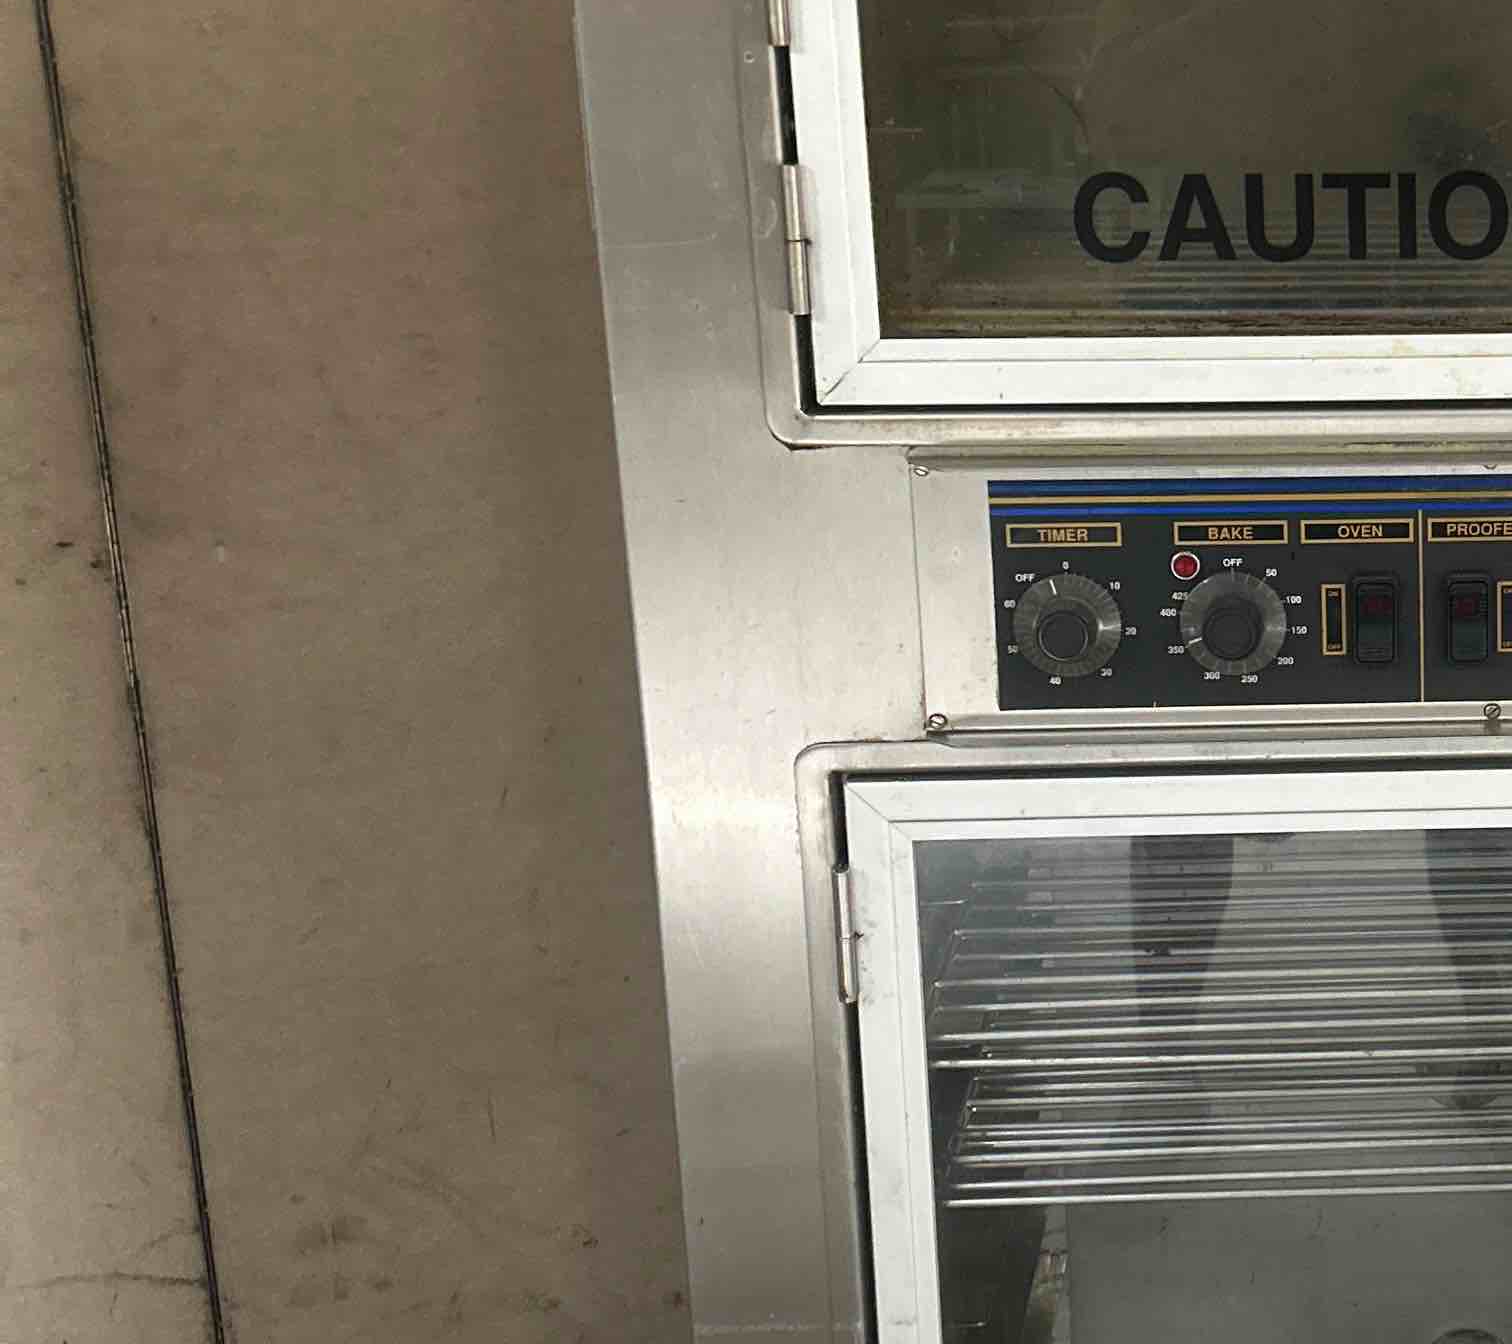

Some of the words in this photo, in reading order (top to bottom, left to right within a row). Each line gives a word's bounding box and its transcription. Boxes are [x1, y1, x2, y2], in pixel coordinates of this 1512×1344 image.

[1037, 528, 1089, 543] TIMER
[1208, 526, 1254, 540] BAKE
[1337, 524, 1384, 538] OVEN
[1062, 560, 1070, 570] 0
[1223, 558, 1244, 567] OFF
[1266, 568, 1278, 577] 50
[1015, 573, 1036, 583] OFF
[1109, 581, 1121, 591] 10
[1172, 592, 1188, 601] 425
[1286, 595, 1302, 604] 100
[1160, 608, 1177, 617] 400
[1291, 626, 1308, 635] 150
[1168, 645, 1185, 654] 350
[1277, 656, 1294, 665] 200
[1203, 671, 1220, 680] 300
[1240, 674, 1258, 683] 250
